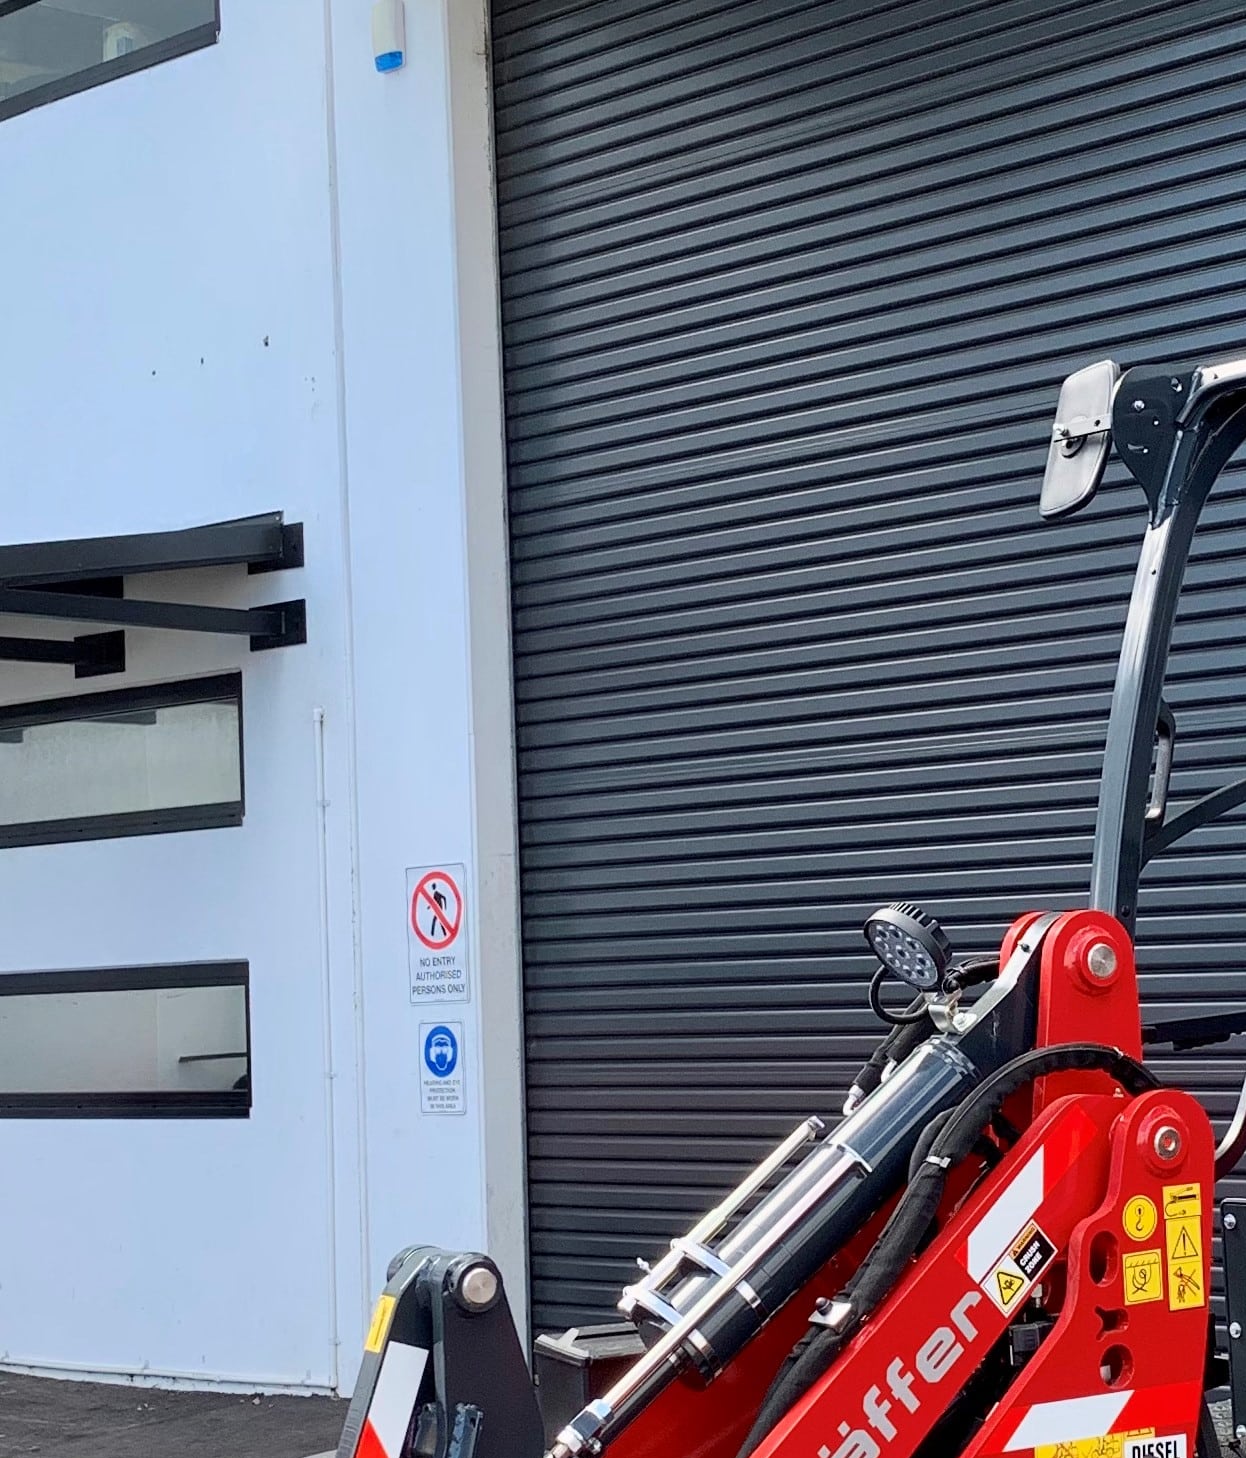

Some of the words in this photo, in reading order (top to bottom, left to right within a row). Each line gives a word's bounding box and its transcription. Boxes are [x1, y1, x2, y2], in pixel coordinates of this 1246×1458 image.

[420, 958, 431, 967] NO
[432, 956, 456, 967] ENTRY
[416, 970, 462, 981] AUTHORISED
[412, 984, 446, 995] PERSONS
[447, 983, 466, 994] ONLY
[1020, 1240, 1041, 1267] CRUSH
[1024, 1251, 1043, 1274] ZONE
